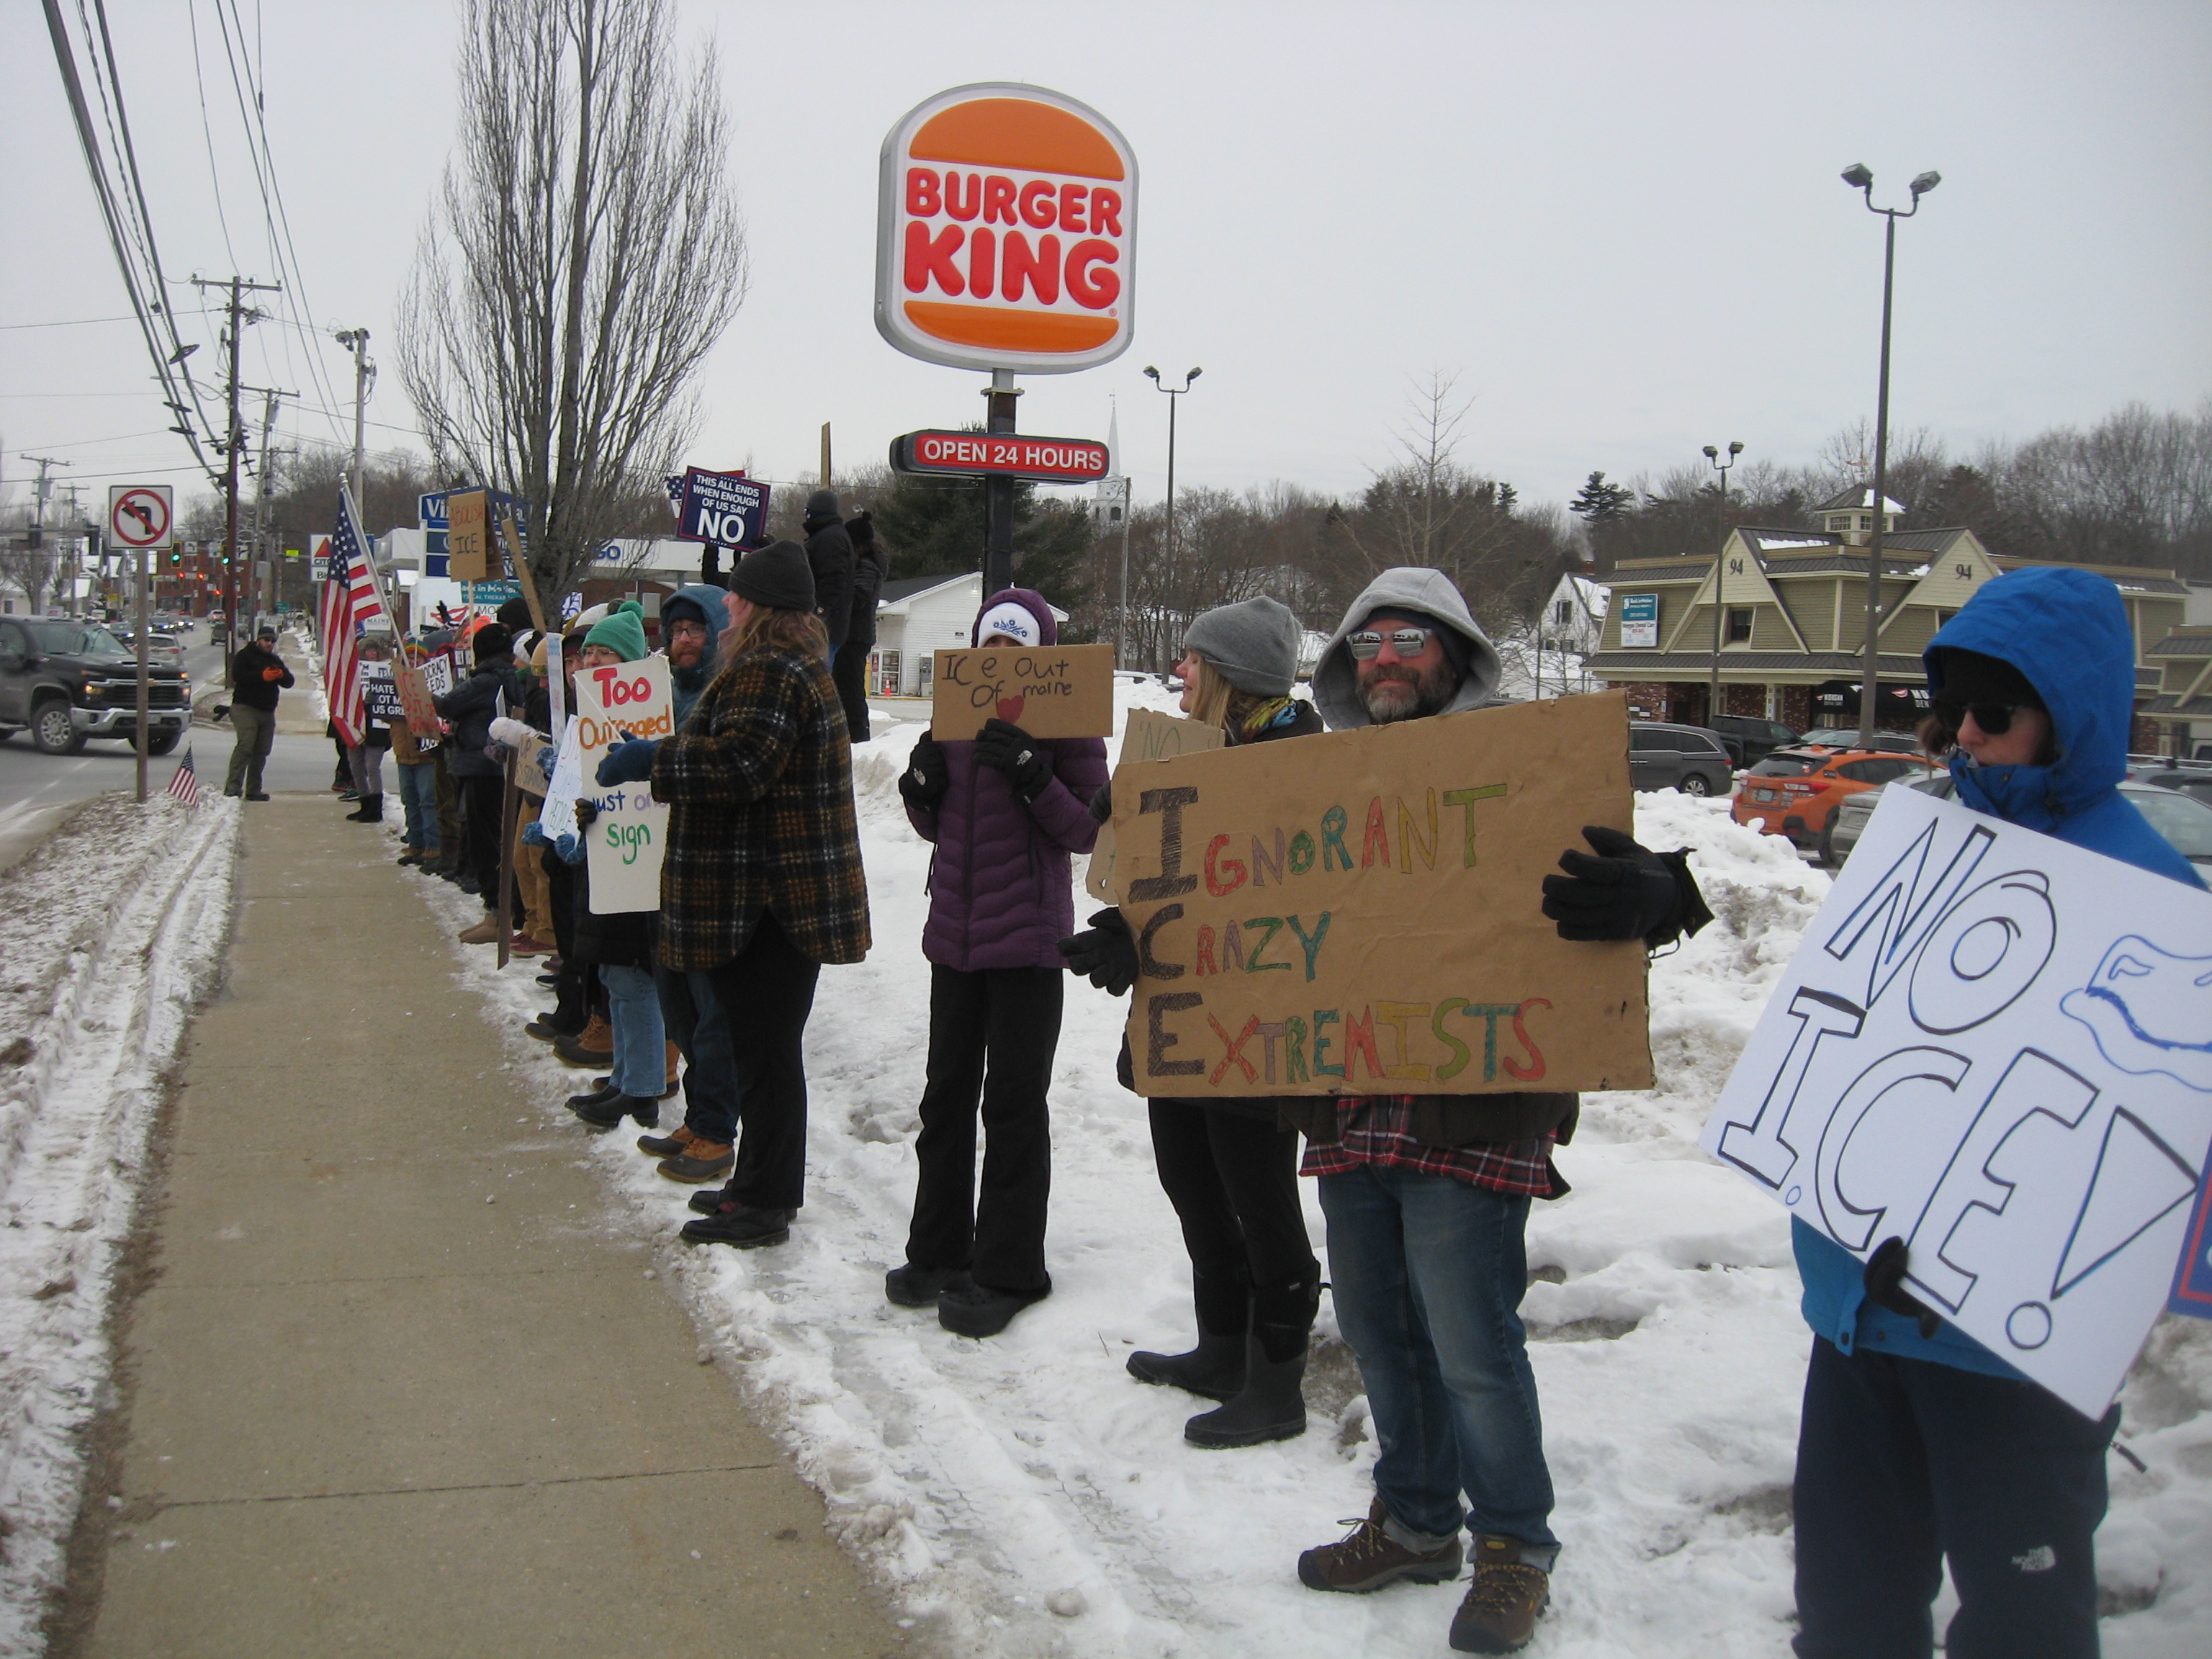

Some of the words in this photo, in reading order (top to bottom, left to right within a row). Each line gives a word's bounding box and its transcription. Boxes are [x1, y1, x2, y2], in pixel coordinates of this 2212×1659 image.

[906, 167, 1123, 237] BURGER
[904, 220, 1120, 310] KING
[924, 439, 987, 462] OPEN
[994, 445, 1018, 464] 24
[1025, 447, 1102, 470] HOURS
[693, 484, 719, 499] WHEN
[721, 491, 760, 508] ENOUGH
[696, 474, 717, 487] THIS
[718, 480, 734, 492] ALL
[734, 484, 760, 498] ENDS
[702, 498, 716, 508] OF
[716, 500, 729, 511] US
[729, 504, 747, 516] SAY
[696, 508, 745, 544] NO
[455, 533, 480, 554] ICE
[1730, 559, 1743, 575] 94
[1956, 564, 1972, 580] 94
[1015, 657, 1069, 679] Out
[371, 683, 395, 694] HATE
[379, 695, 392, 704] OT
[593, 667, 652, 709] Too
[971, 680, 1005, 710] Of
[1022, 682, 1072, 698] maine
[372, 705, 386, 714] US
[579, 703, 671, 750] Outraged
[593, 790, 626, 812] ust
[1128, 783, 1507, 904] IGNORANT
[1825, 816, 2057, 1035] NO
[1139, 903, 1331, 982] CRAZY
[1147, 992, 1553, 1085] EXTREMISTS
